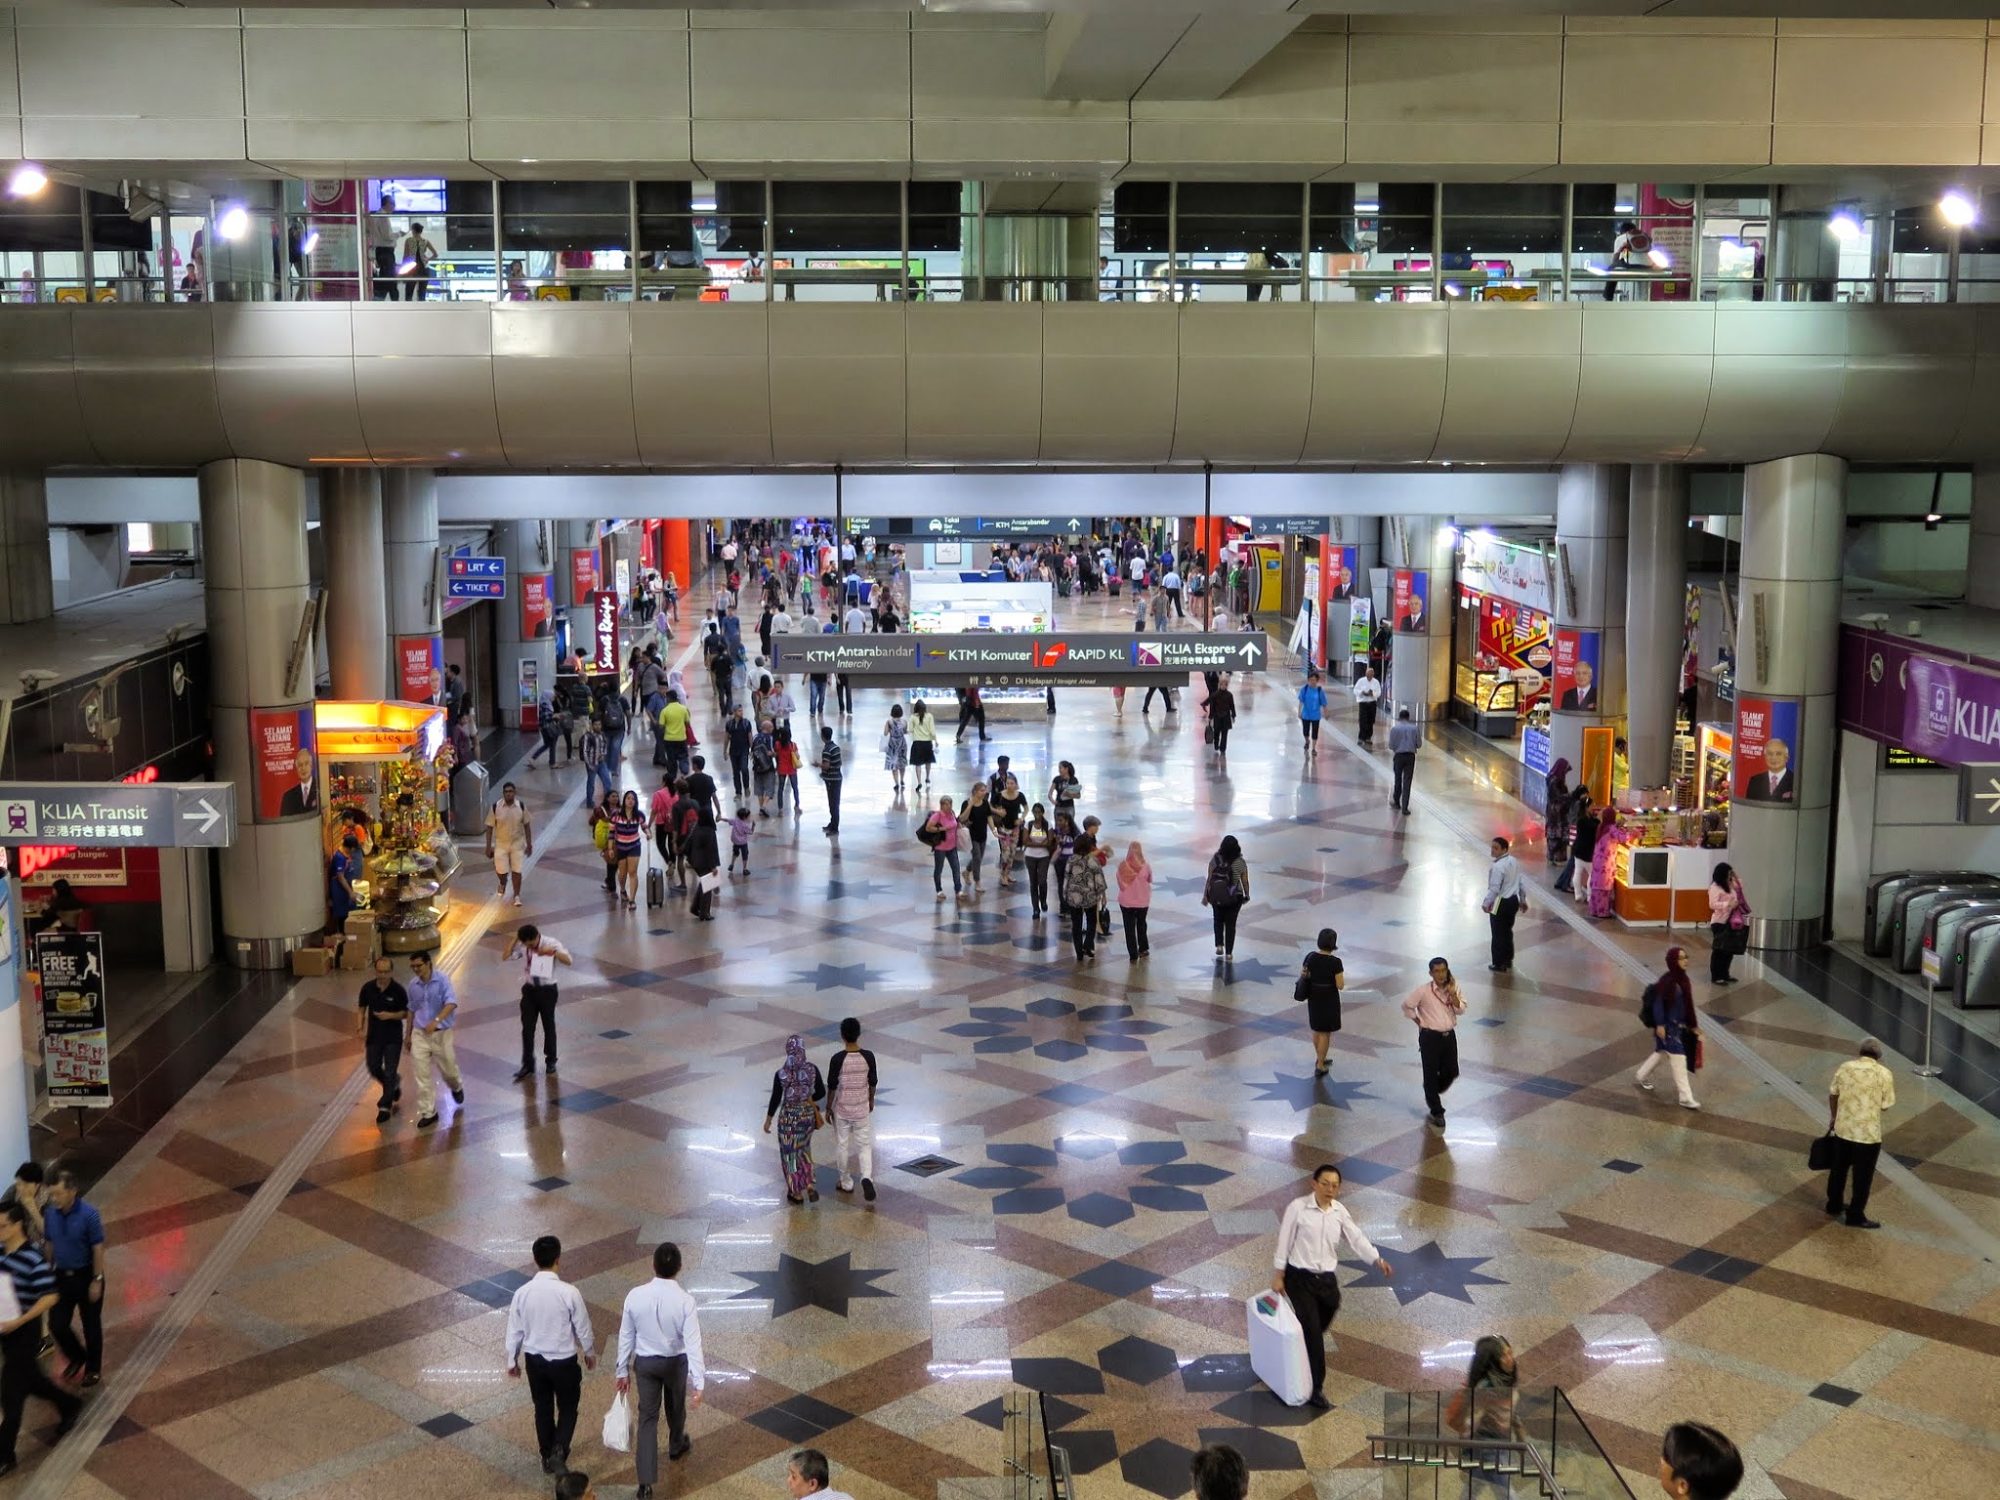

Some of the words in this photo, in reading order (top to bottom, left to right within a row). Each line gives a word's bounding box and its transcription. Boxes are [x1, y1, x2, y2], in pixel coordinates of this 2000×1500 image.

[995, 521, 1010, 529] KTM
[467, 563, 485, 572] LRT
[465, 583, 490, 592] TIKET
[806, 650, 835, 662] KTM
[836, 645, 914, 657] Antarabandar
[948, 649, 977, 661] KTM
[980, 649, 1032, 661] Komuter
[1068, 649, 1106, 660] RAPID
[1109, 649, 1125, 660] KL
[1164, 643, 1192, 654] KLIA
[1194, 643, 1237, 656] Ekspres
[836, 659, 872, 670] Intercity
[264, 726, 293, 736] SELAMAT
[42, 803, 86, 820] KLIA
[88, 803, 149, 820] Transit
[78, 851, 109, 860] burger.
